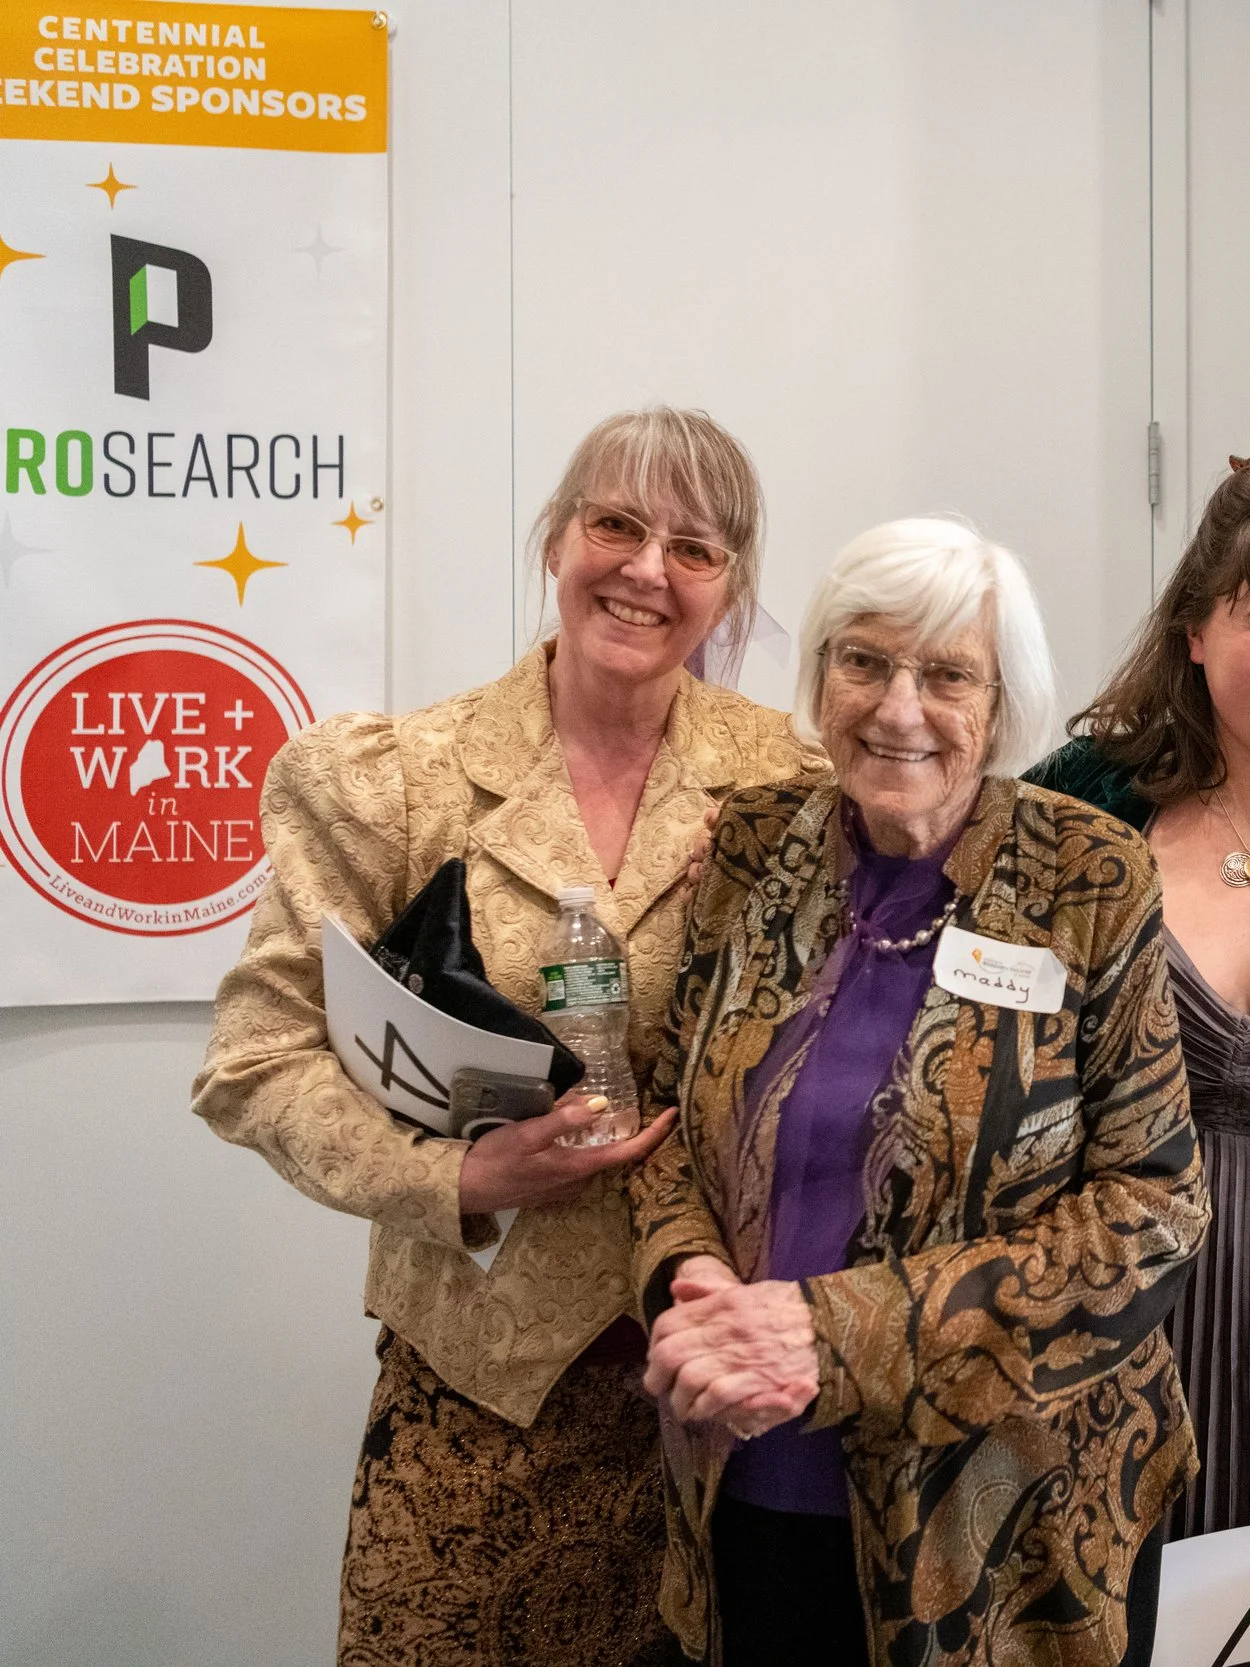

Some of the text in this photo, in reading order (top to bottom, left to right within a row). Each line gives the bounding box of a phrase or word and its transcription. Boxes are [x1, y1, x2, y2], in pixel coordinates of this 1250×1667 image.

[38, 15, 266, 49] CENTENNIAL
[34, 47, 267, 81] CELEBRATION
[0, 78, 367, 122] EKEND SPONSORS
[71, 692, 206, 735] LIVE
[70, 745, 253, 790] WRK
[148, 791, 178, 816] in
[70, 819, 254, 864] MAINE
[49, 872, 268, 926] LiveandWorkinMaine.com
